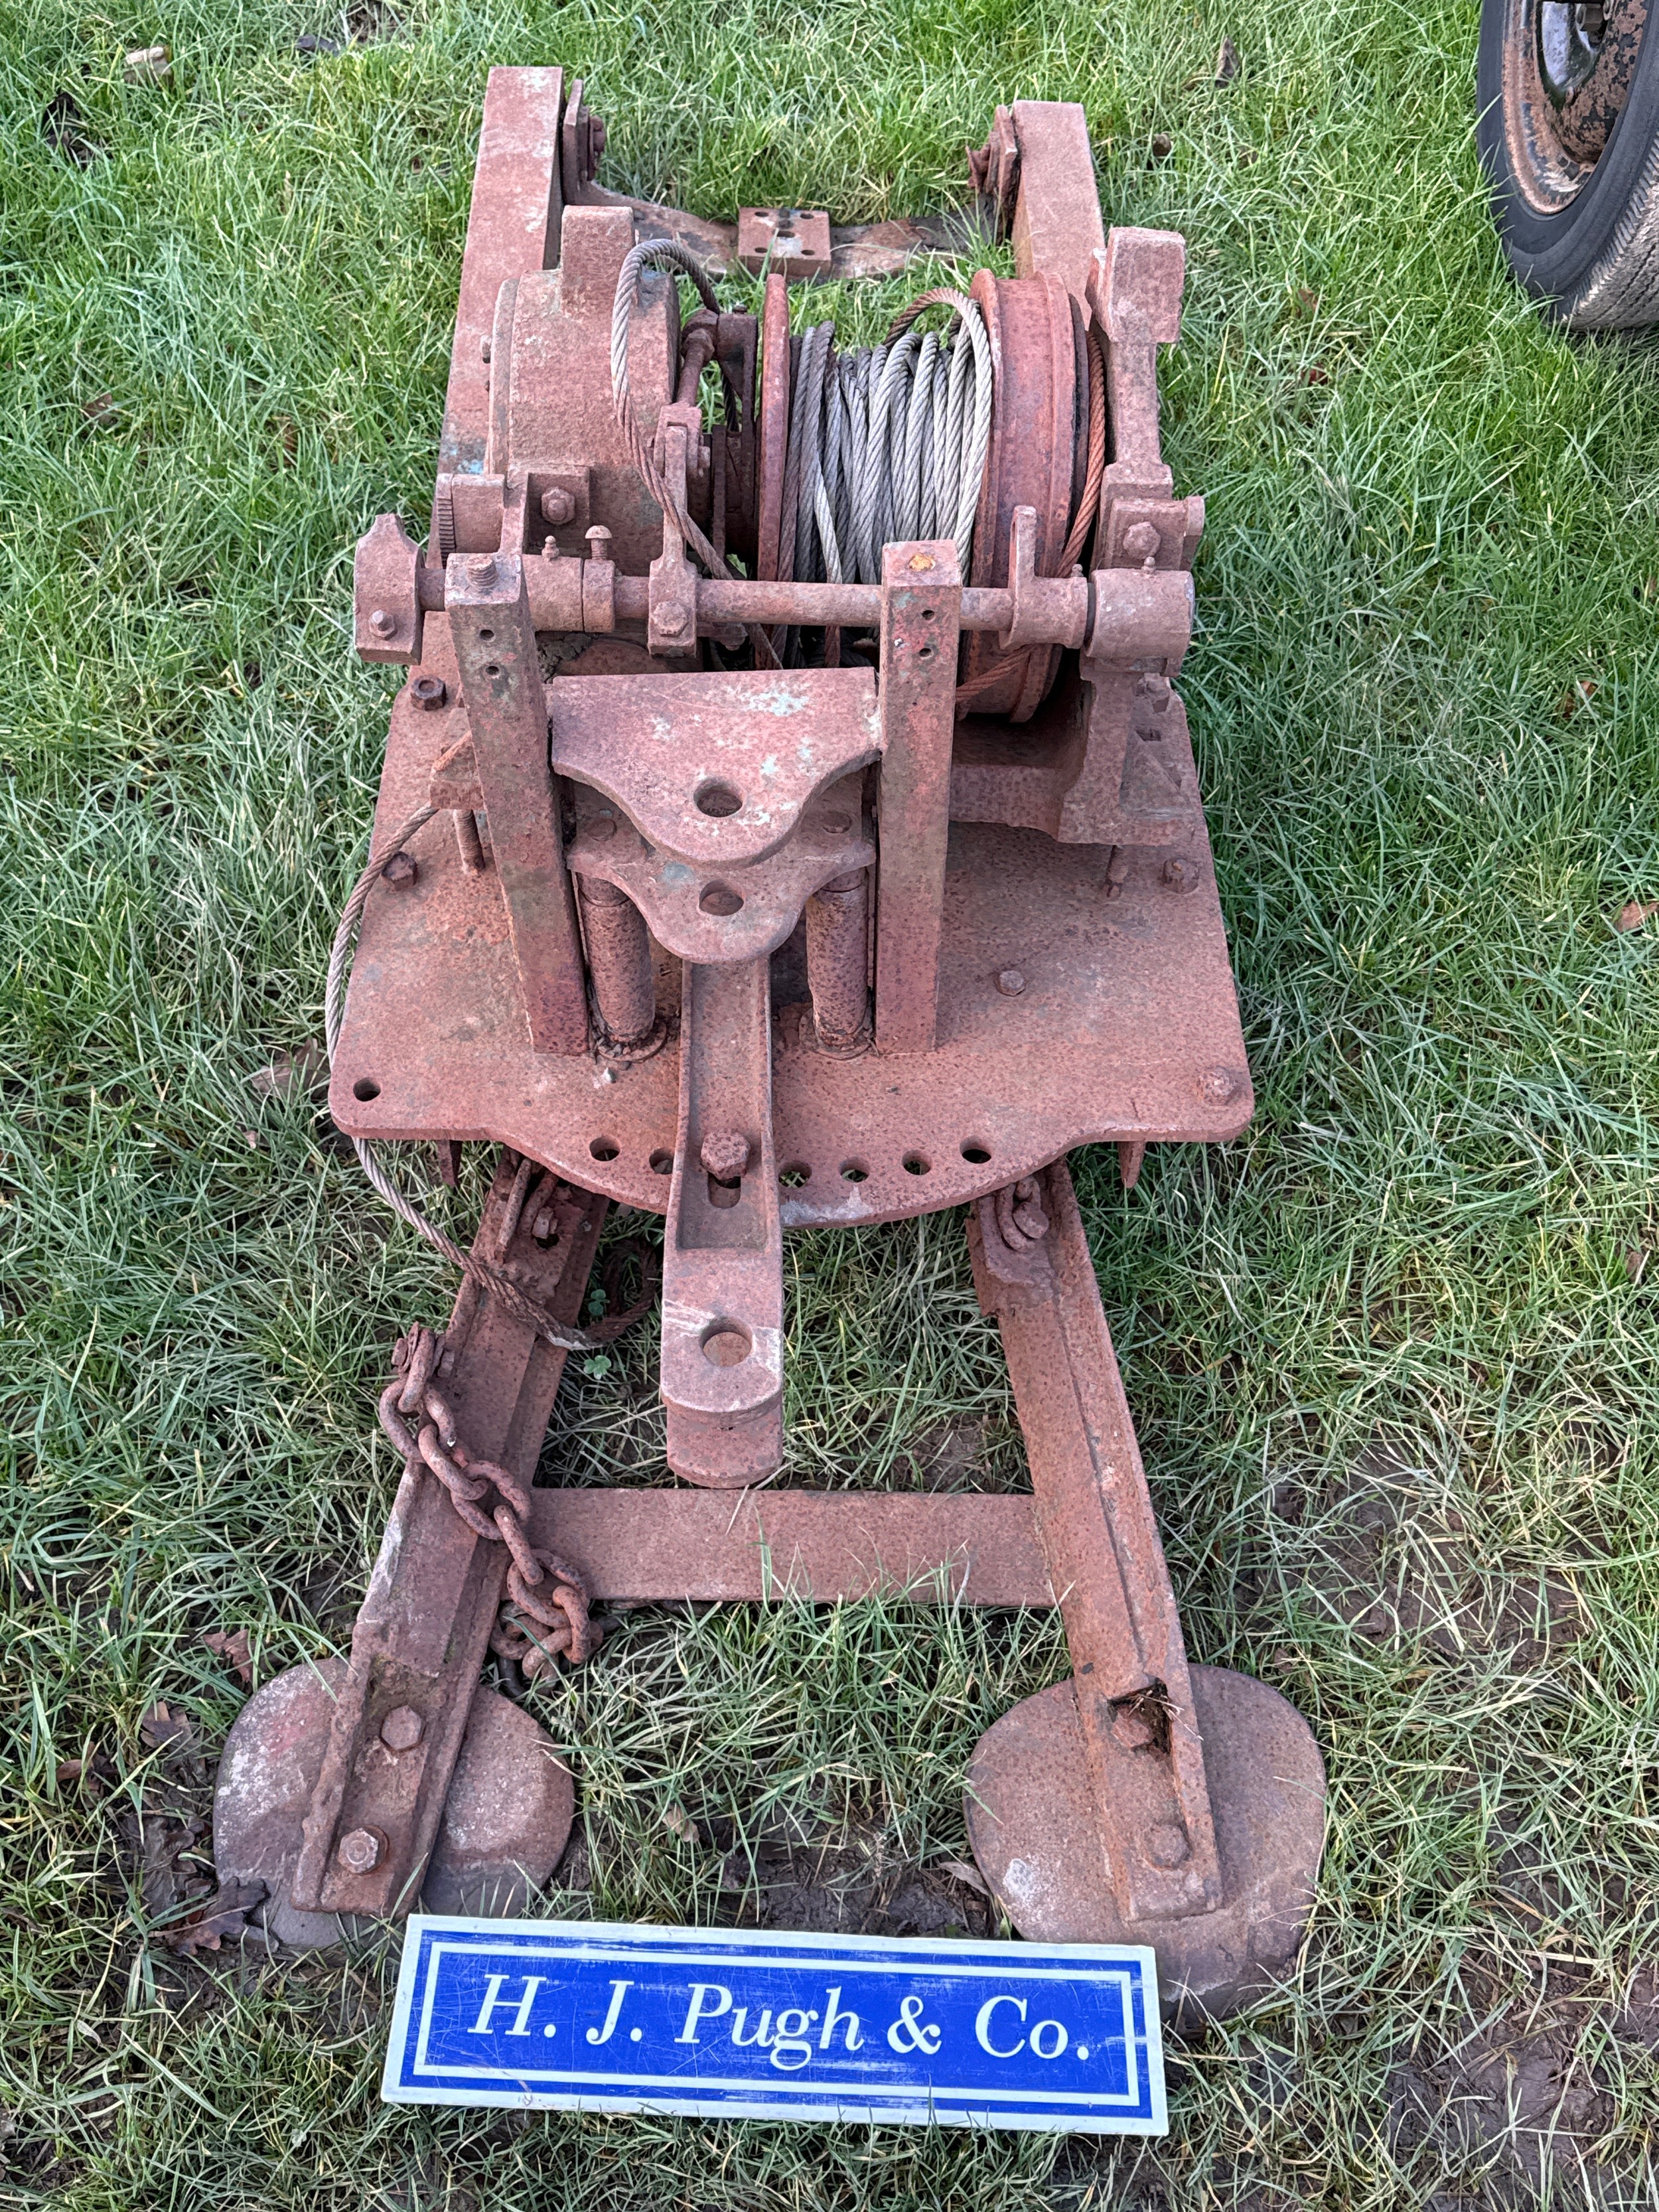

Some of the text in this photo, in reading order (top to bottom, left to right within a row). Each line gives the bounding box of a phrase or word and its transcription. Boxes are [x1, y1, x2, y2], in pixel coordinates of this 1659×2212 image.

[467, 1973, 1089, 2071] H. J. Pugh & Co.
